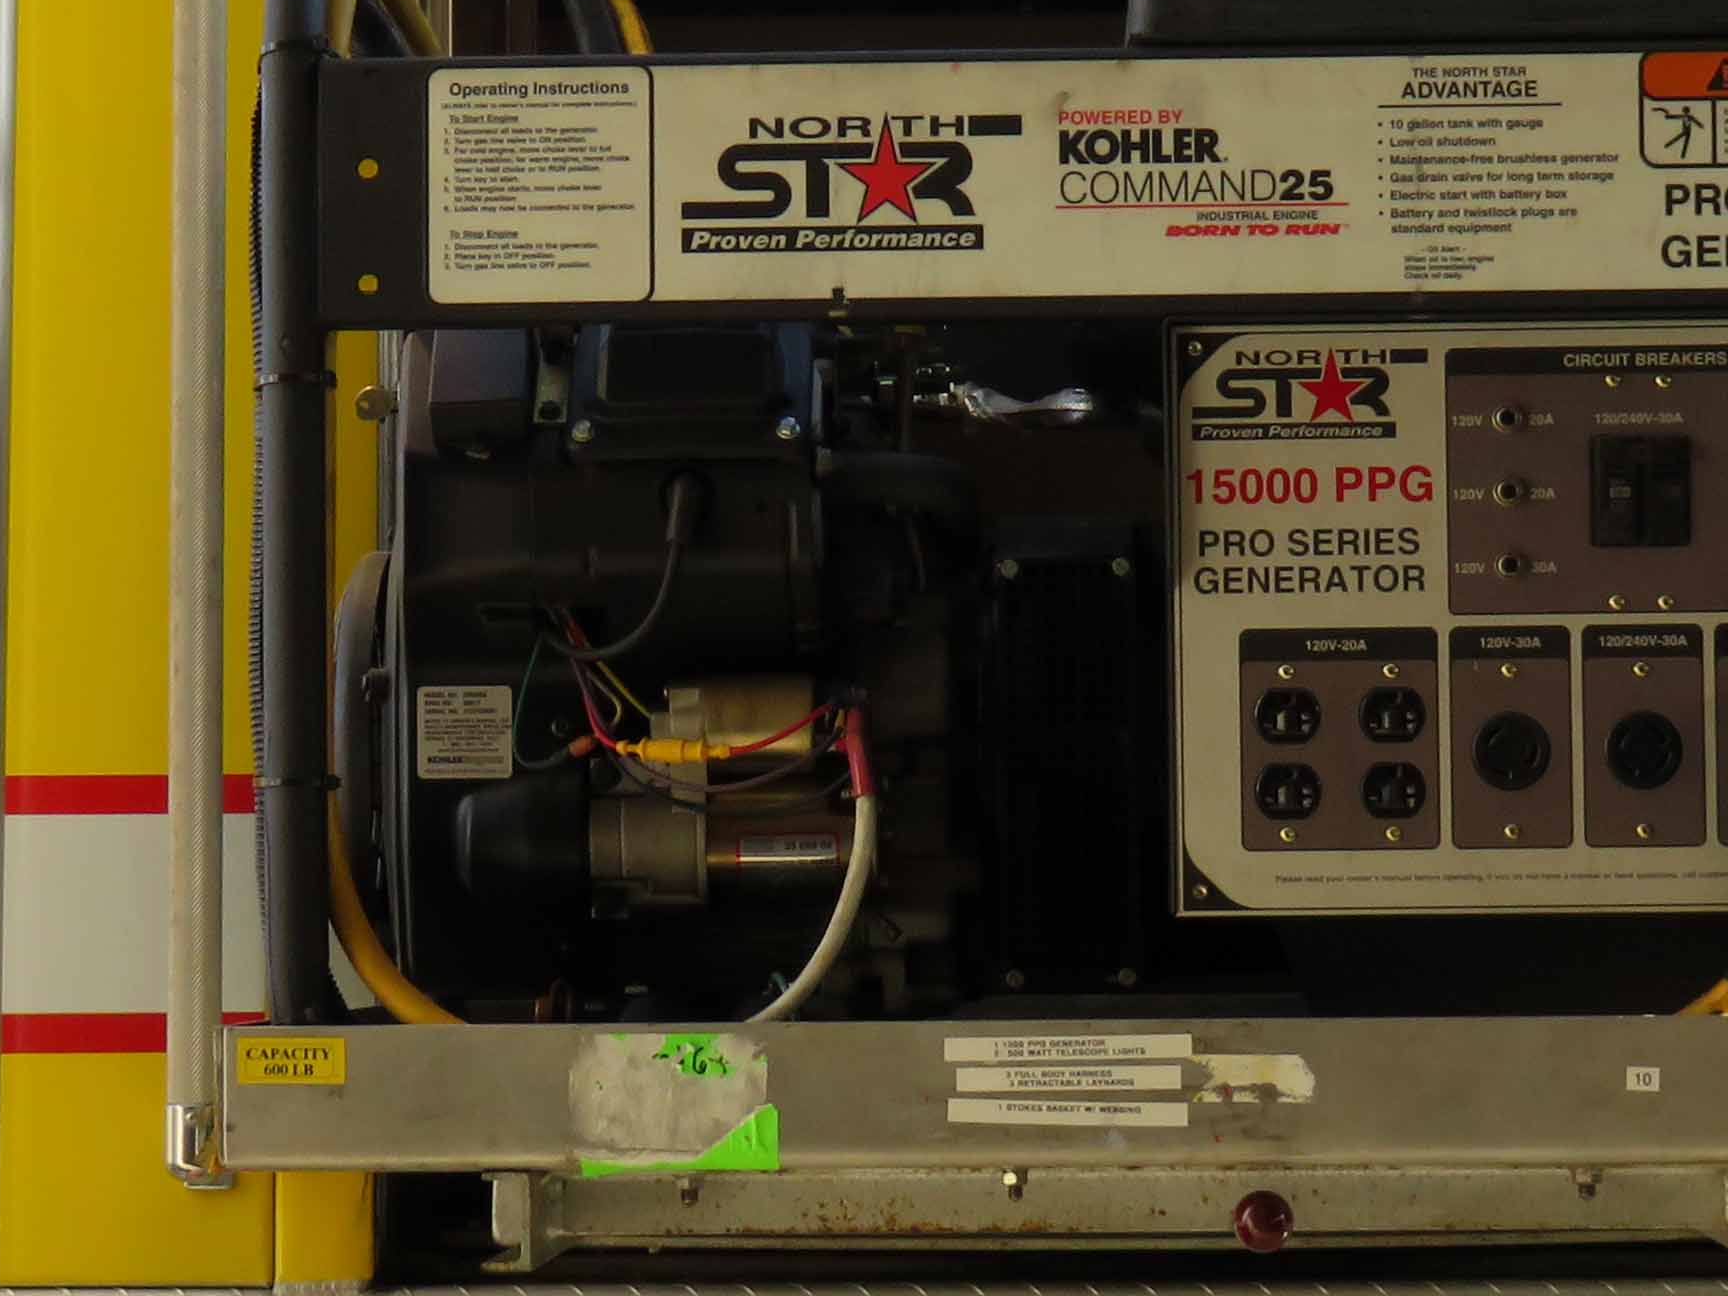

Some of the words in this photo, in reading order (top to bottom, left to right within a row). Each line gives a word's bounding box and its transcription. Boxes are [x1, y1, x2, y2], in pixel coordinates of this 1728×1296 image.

[1413, 67, 1437, 78] THE
[1443, 67, 1489, 78] NORTH
[1493, 67, 1527, 77] STAR
[449, 82, 528, 99] Operating
[533, 81, 629, 95] Instructions
[1401, 80, 1538, 99] ADVANTAGE
[1058, 111, 1154, 126] POWERED
[1159, 110, 1183, 124] BY
[749, 114, 966, 139] NORTH
[1390, 119, 1403, 130] 10
[1407, 118, 1444, 132] gallon
[1448, 118, 1472, 128] tank
[1476, 118, 1502, 128] with
[1506, 118, 1543, 130] gauge
[1058, 129, 1221, 165] KOHLER
[1390, 137, 1415, 147] Low
[1418, 137, 1432, 147] oil
[1437, 136, 1496, 147] shutdown
[1390, 154, 1493, 165] Maintenance-free
[1497, 153, 1556, 164] brushless
[1560, 153, 1618, 165] generator
[1390, 173, 1413, 183] Gas
[1417, 172, 1448, 182] drain
[1452, 172, 1482, 182] valve
[1487, 172, 1502, 182] for
[1507, 171, 1533, 184] long
[1537, 171, 1564, 181] term
[1568, 171, 1614, 183] storage
[1390, 190, 1435, 200] Electric
[1439, 190, 1467, 200] start
[1472, 189, 1496, 199] with
[1500, 189, 1541, 201] battery
[1545, 189, 1567, 199] box
[1196, 210, 1270, 222] INDUSTRIAL
[1274, 209, 1318, 221] ENGINE
[1390, 208, 1433, 220] Battery
[1437, 208, 1460, 218] and
[1521, 207, 1554, 219] plugs
[1558, 208, 1577, 216] are
[1165, 226, 1241, 237] BORN
[1246, 225, 1281, 236] TO
[1286, 224, 1342, 235] RUN
[1391, 224, 1444, 233] standard
[1448, 223, 1512, 235] equipment
[690, 229, 787, 252] Proven
[794, 228, 976, 250] Performance
[1235, 349, 1387, 365] NORTH
[1563, 354, 1631, 368] CIRCUIT
[1635, 351, 1728, 366] BREAKERS
[1199, 426, 1263, 440] Proven
[1268, 425, 1383, 439] Performance
[1185, 468, 1318, 504] 15000
[1335, 466, 1433, 502] PPG
[1198, 529, 1274, 557] PRO
[1287, 527, 1420, 555] SERIES
[1194, 565, 1426, 594] GENERATOR
[1305, 639, 1368, 651] 120V-20A
[1479, 637, 1541, 650] 120V-30A
[1599, 635, 1688, 648] 120/240V-30A
[1049, 1039, 1106, 1048] GENERATOR
[246, 1047, 330, 1060] CAPACITY
[1056, 1048, 1109, 1056] TELESCOPE
[264, 1064, 288, 1076] 600
[1018, 1079, 1082, 1087] RETRACTABLE
[1634, 1072, 1652, 1086] 10
